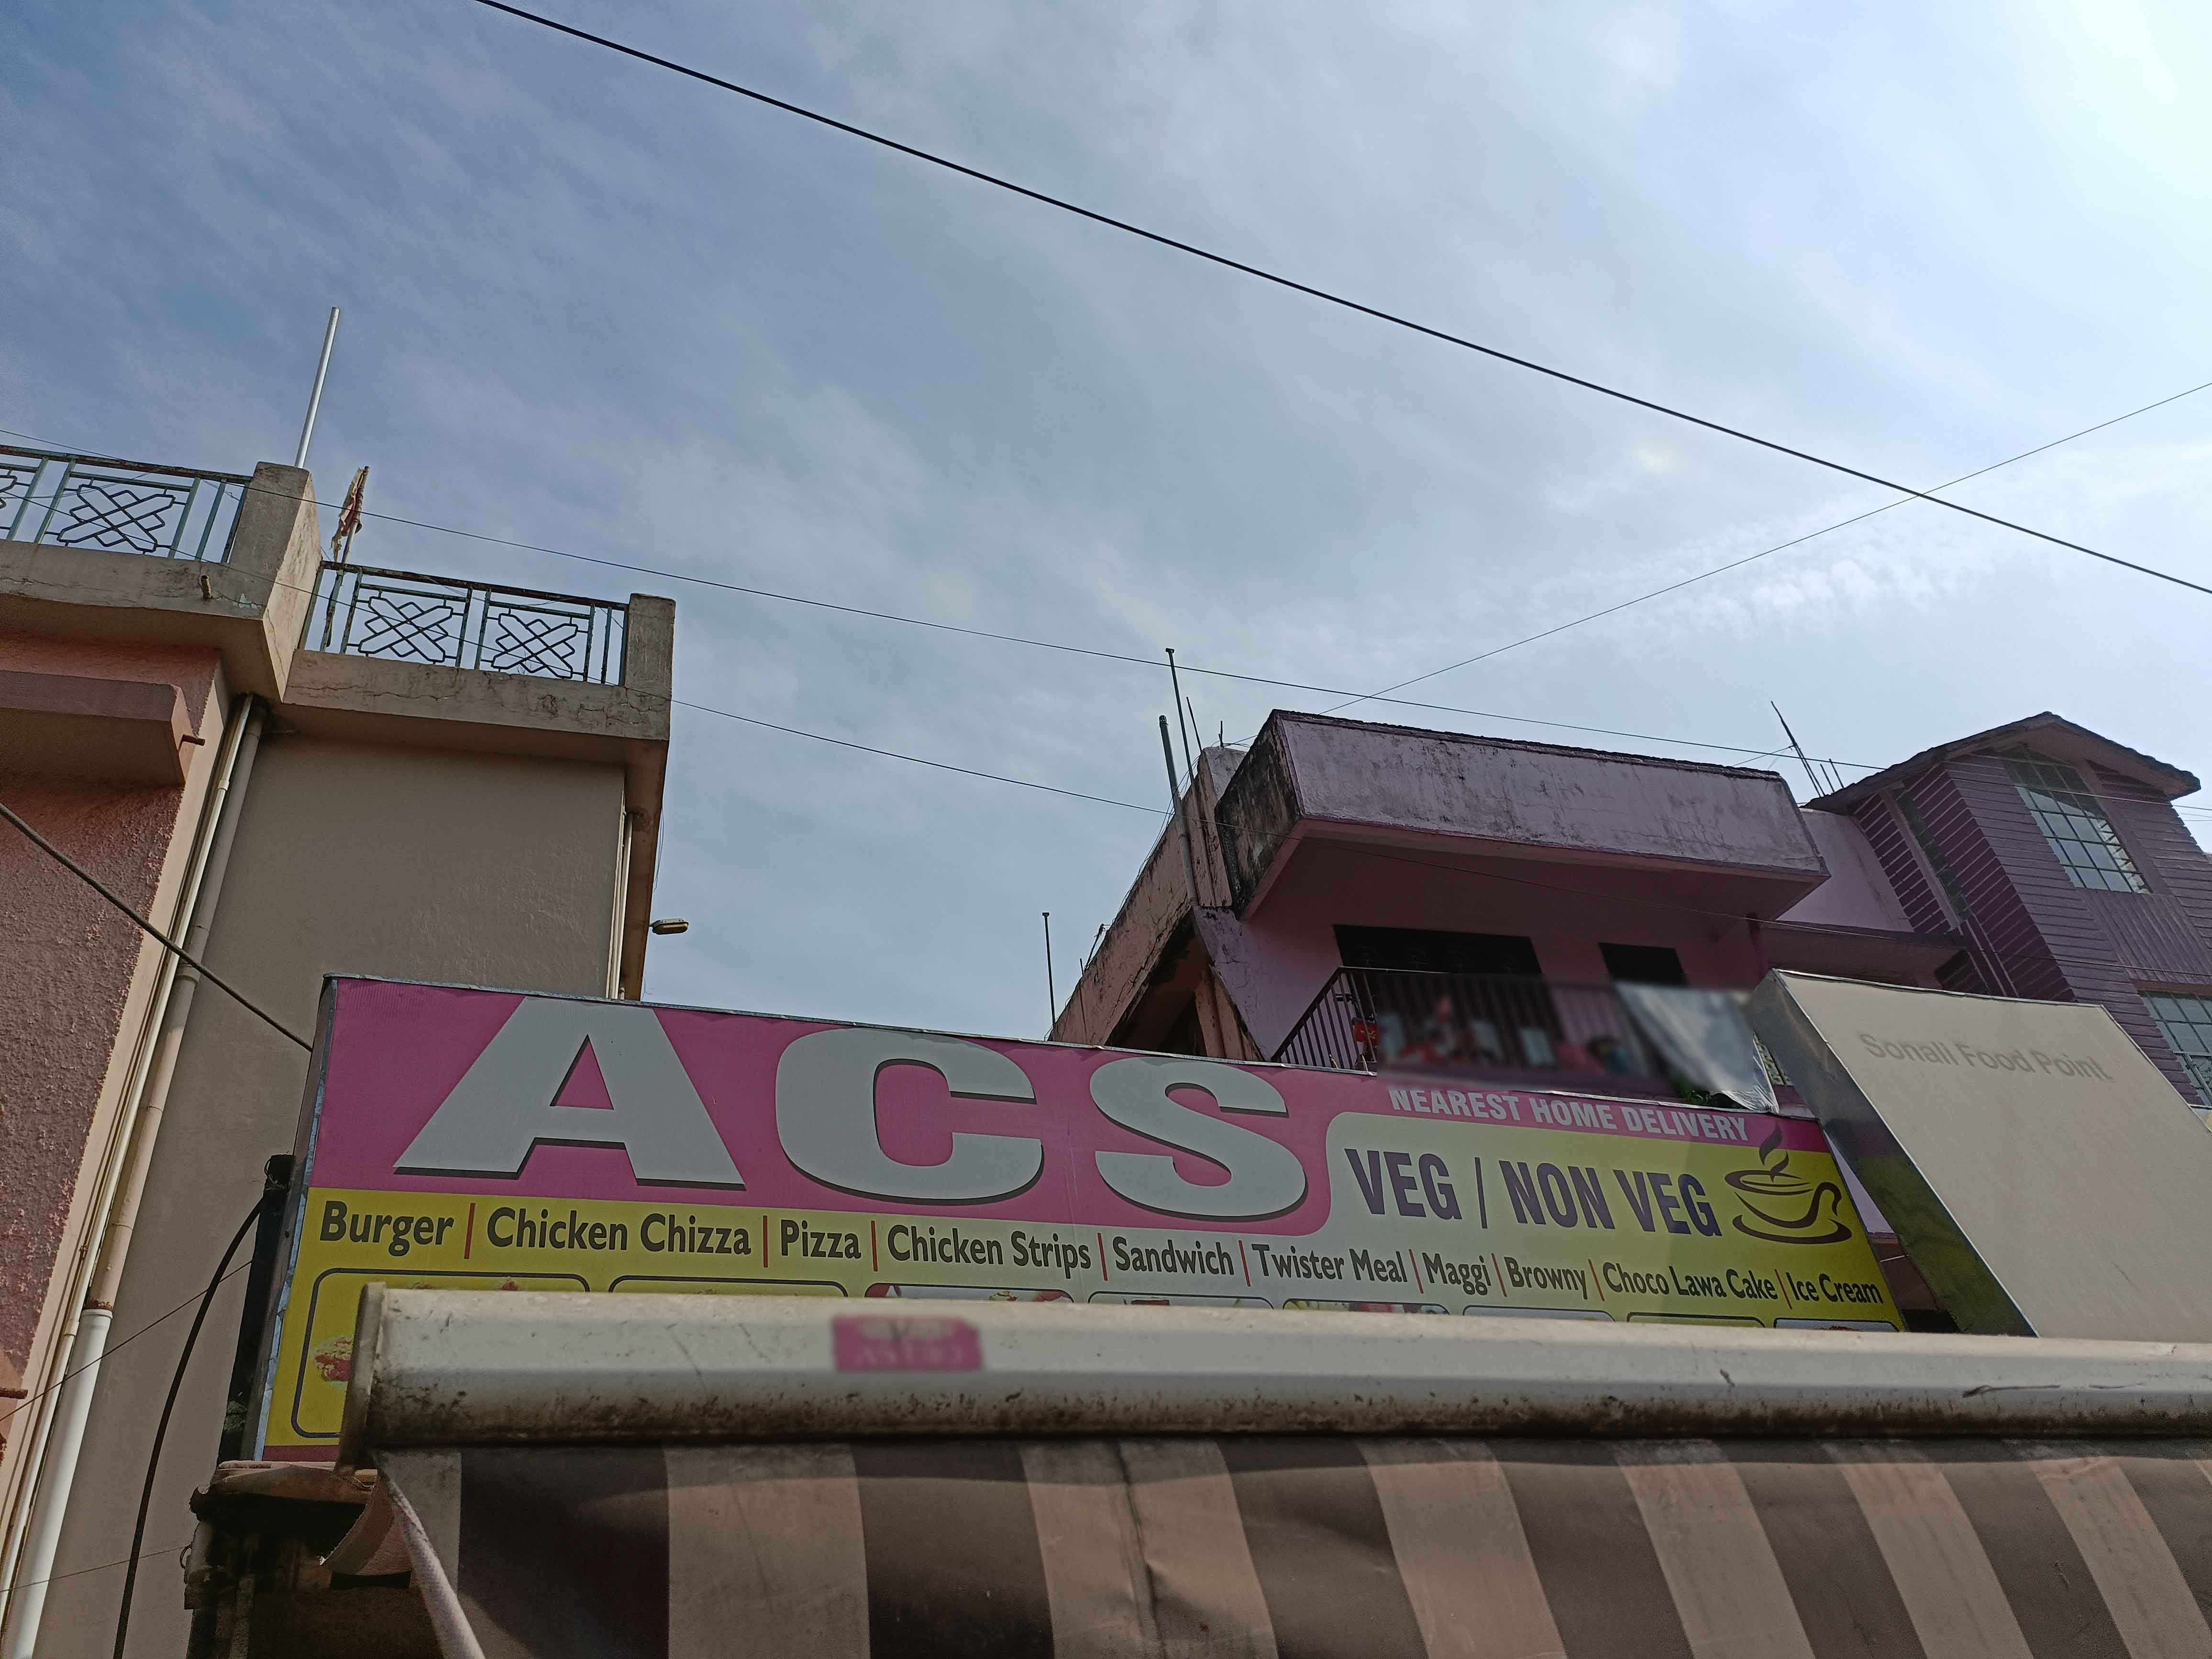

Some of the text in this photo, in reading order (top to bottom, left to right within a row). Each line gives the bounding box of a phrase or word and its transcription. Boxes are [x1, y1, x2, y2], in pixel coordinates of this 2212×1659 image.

[1951, 1040, 2036, 1073] Food
[2029, 1048, 2116, 1083] Point
[392, 995, 1308, 1223] ACS
[1388, 1090, 1749, 1142] NEAREST HOME DELIVERY
[1344, 1148, 1462, 1220] VEG
[1498, 1160, 1615, 1230] NON
[1613, 1169, 1722, 1237] VEG
[320, 1201, 1883, 1304] Burger Chicken Chizza Pizza Chicken Strips Sandwich Twister Meal Maggi Browny Choco Lawa Cake Ice Cream
